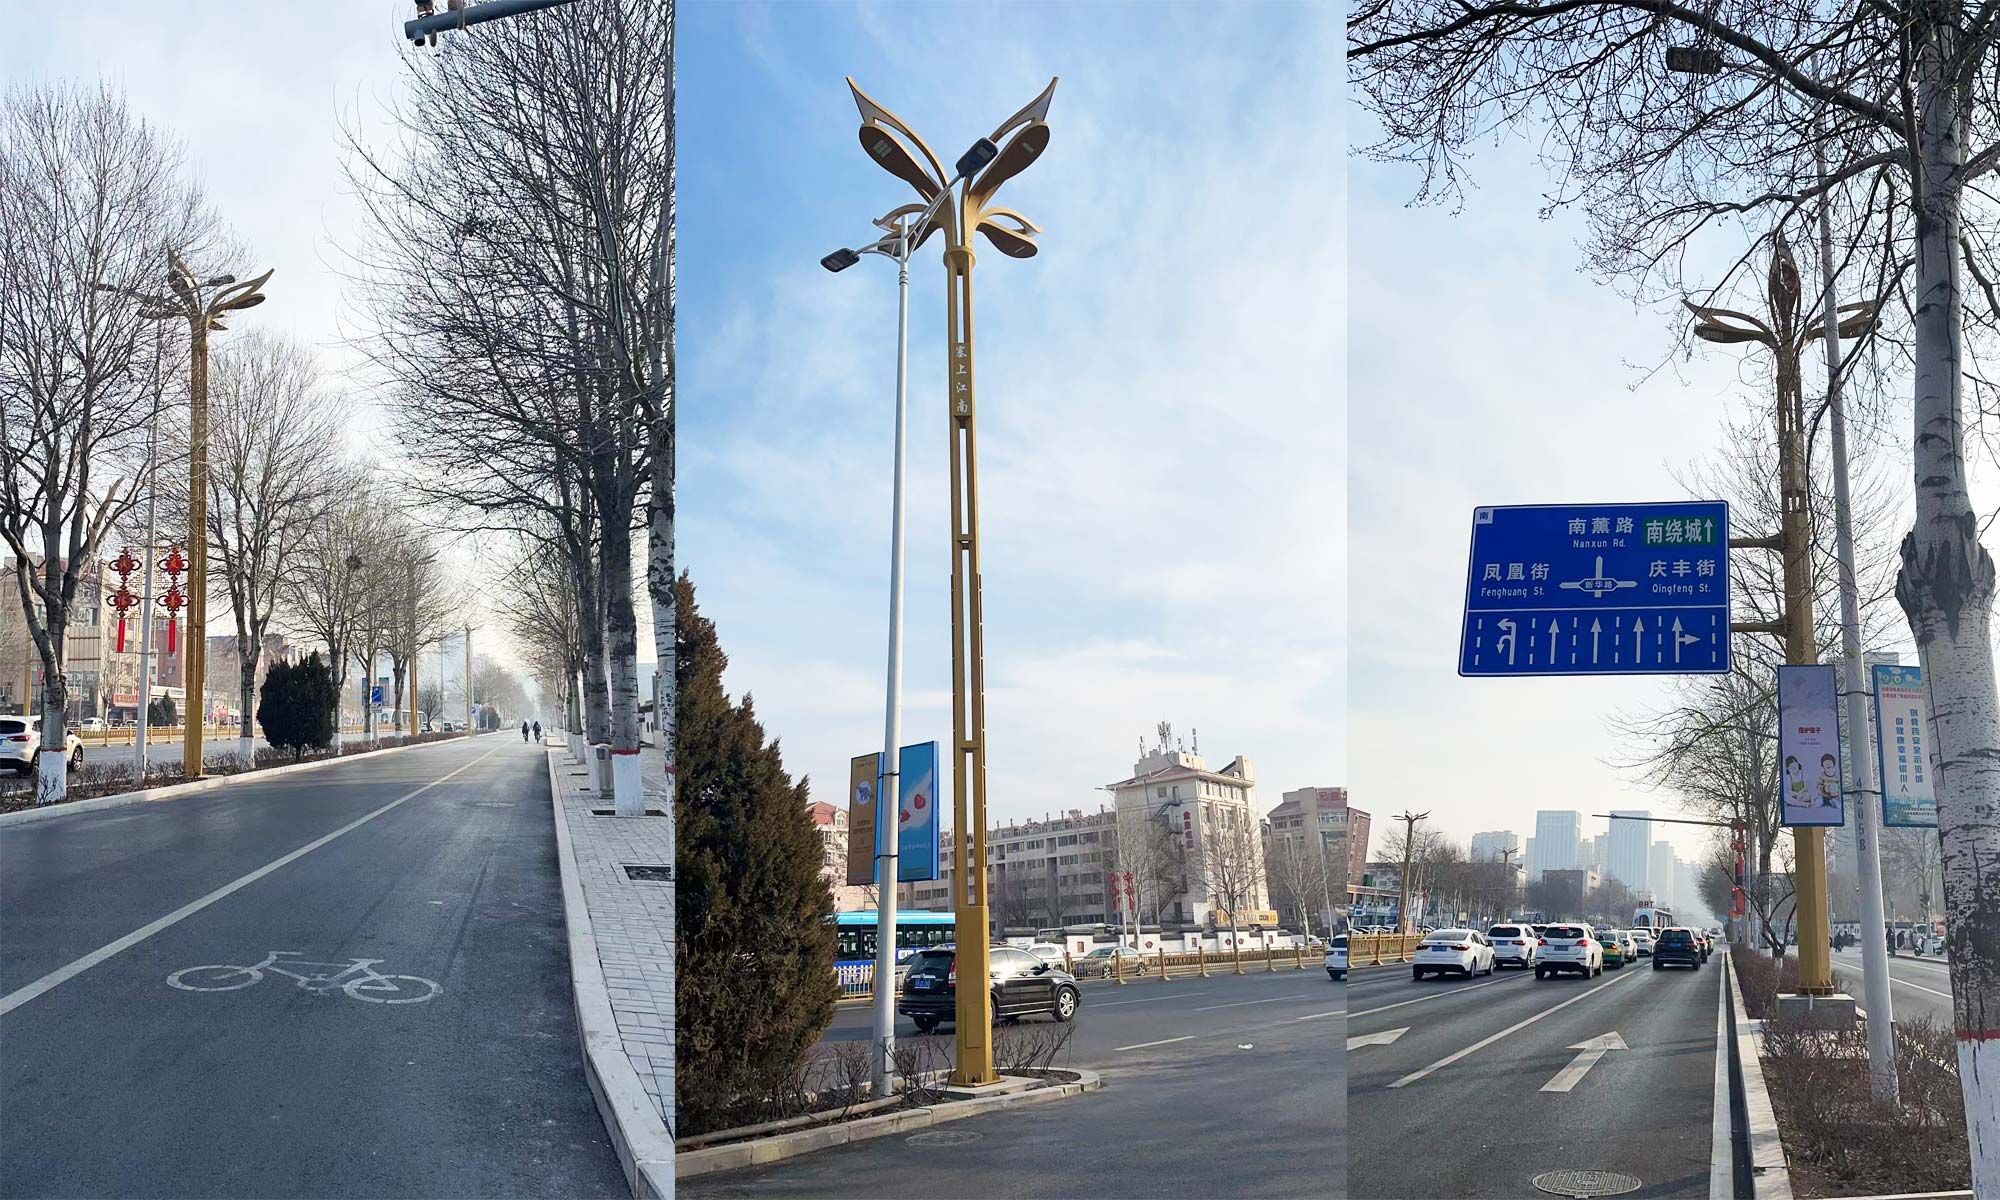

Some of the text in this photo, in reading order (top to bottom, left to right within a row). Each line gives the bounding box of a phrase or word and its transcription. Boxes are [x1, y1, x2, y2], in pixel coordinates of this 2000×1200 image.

[1480, 511, 1489, 520] 南
[1567, 517, 1634, 535] 南薰路
[1646, 518, 1702, 544] 南绕城
[1573, 538, 1626, 548] Nanxun Rd.
[1483, 563, 1550, 581] 凤凰街
[1648, 560, 1716, 577] 庆丰街
[1584, 580, 1613, 589] 新华路
[1652, 583, 1711, 595] Qingfeng St.
[1481, 586, 1545, 599] Fenghuang St.
[1639, 900, 1654, 908] BRT
